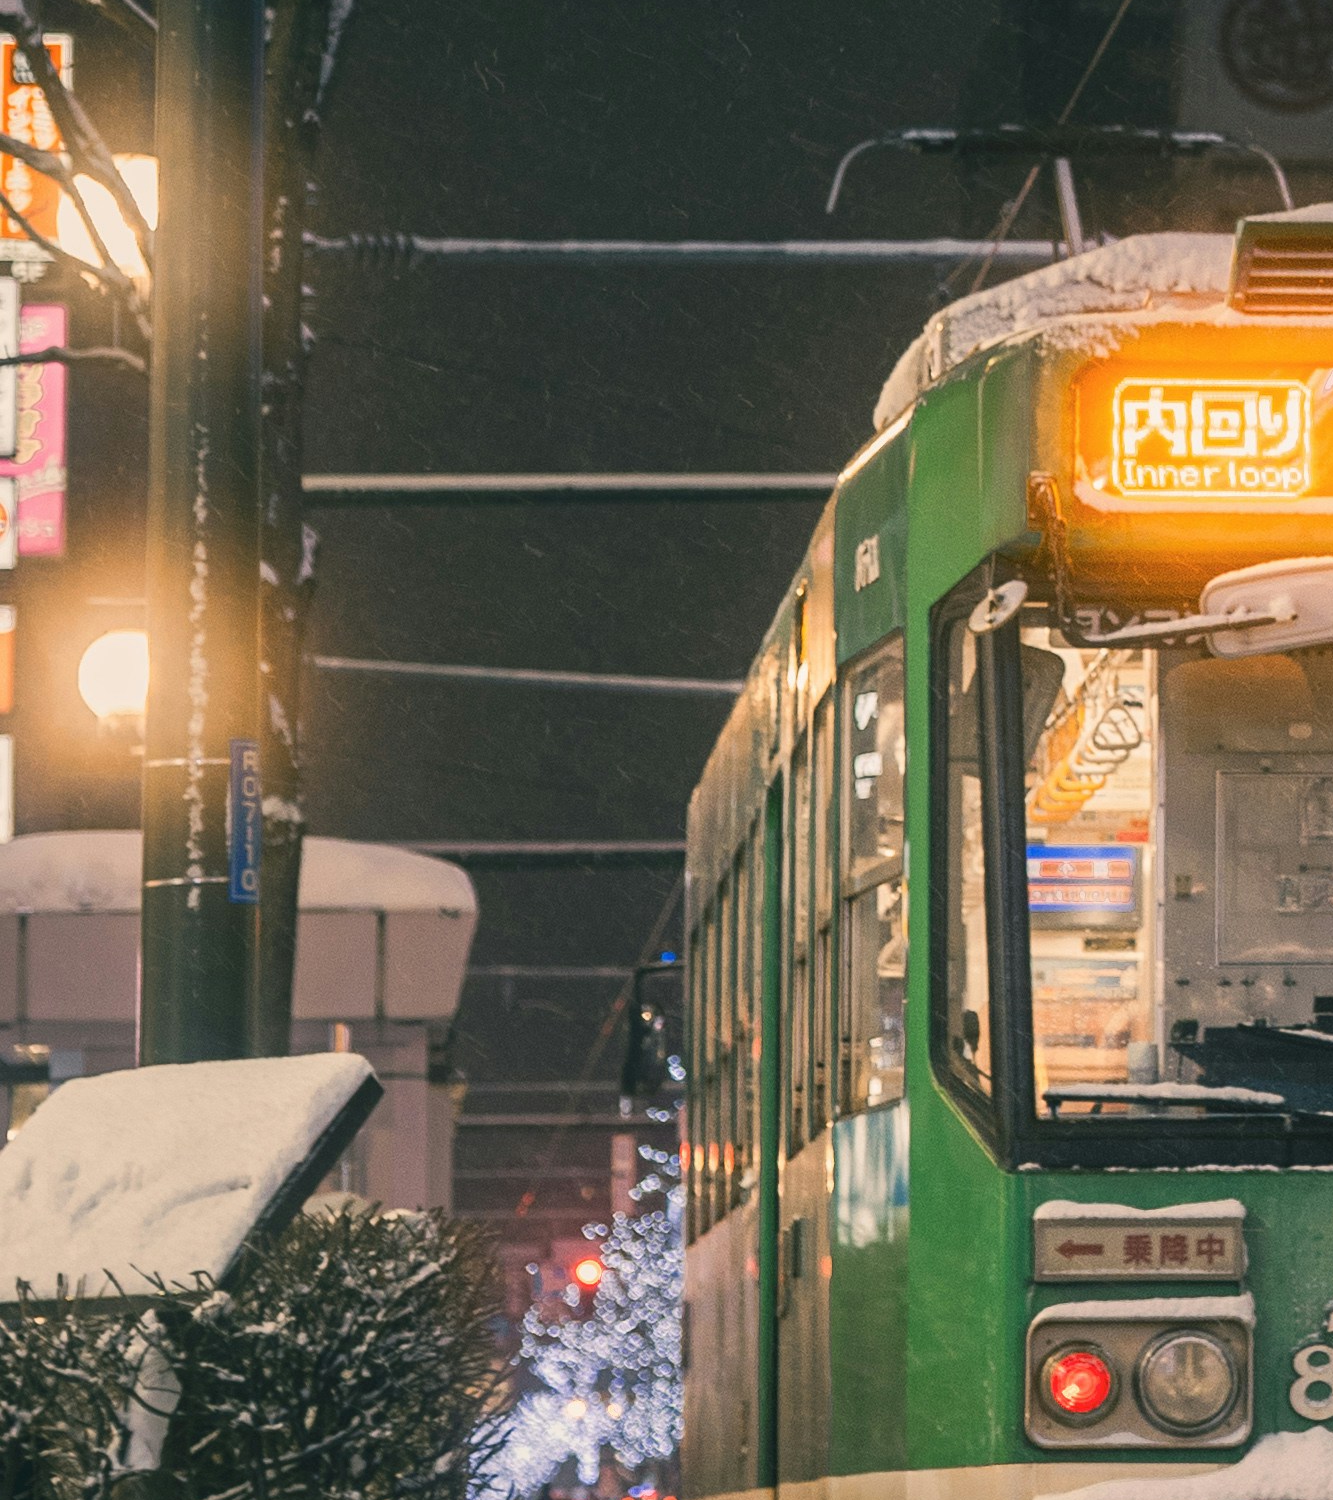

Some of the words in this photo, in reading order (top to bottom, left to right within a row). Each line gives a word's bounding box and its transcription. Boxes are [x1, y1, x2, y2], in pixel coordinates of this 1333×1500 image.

[1122, 387, 1302, 457] 内回り
[1123, 459, 1221, 488] Inner
[1228, 461, 1303, 489] loop
[1123, 1233, 1226, 1265] 乗降中
